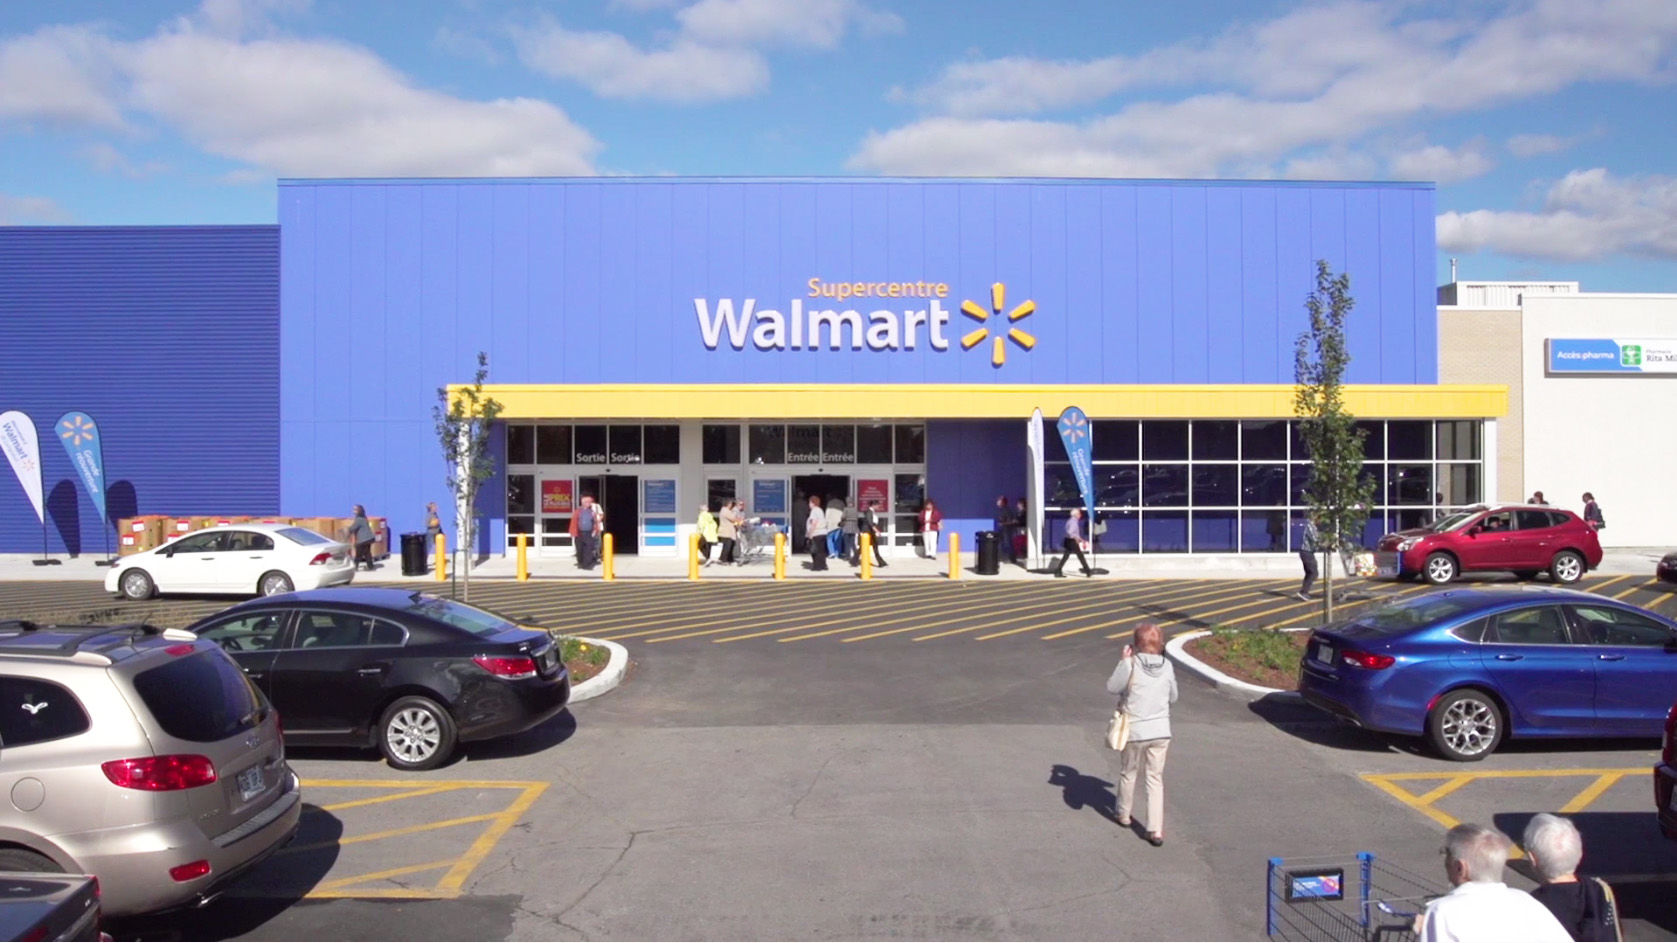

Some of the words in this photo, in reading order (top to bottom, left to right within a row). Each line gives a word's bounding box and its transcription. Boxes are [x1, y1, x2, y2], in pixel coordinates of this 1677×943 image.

[807, 277, 949, 301] Supercentre
[694, 298, 949, 352] Walmart
[1582, 351, 1614, 361] pharma
[3, 422, 28, 459] Walmart
[576, 452, 606, 463] Sortie
[788, 451, 819, 462] Entrée
[823, 451, 855, 462] Entrée
